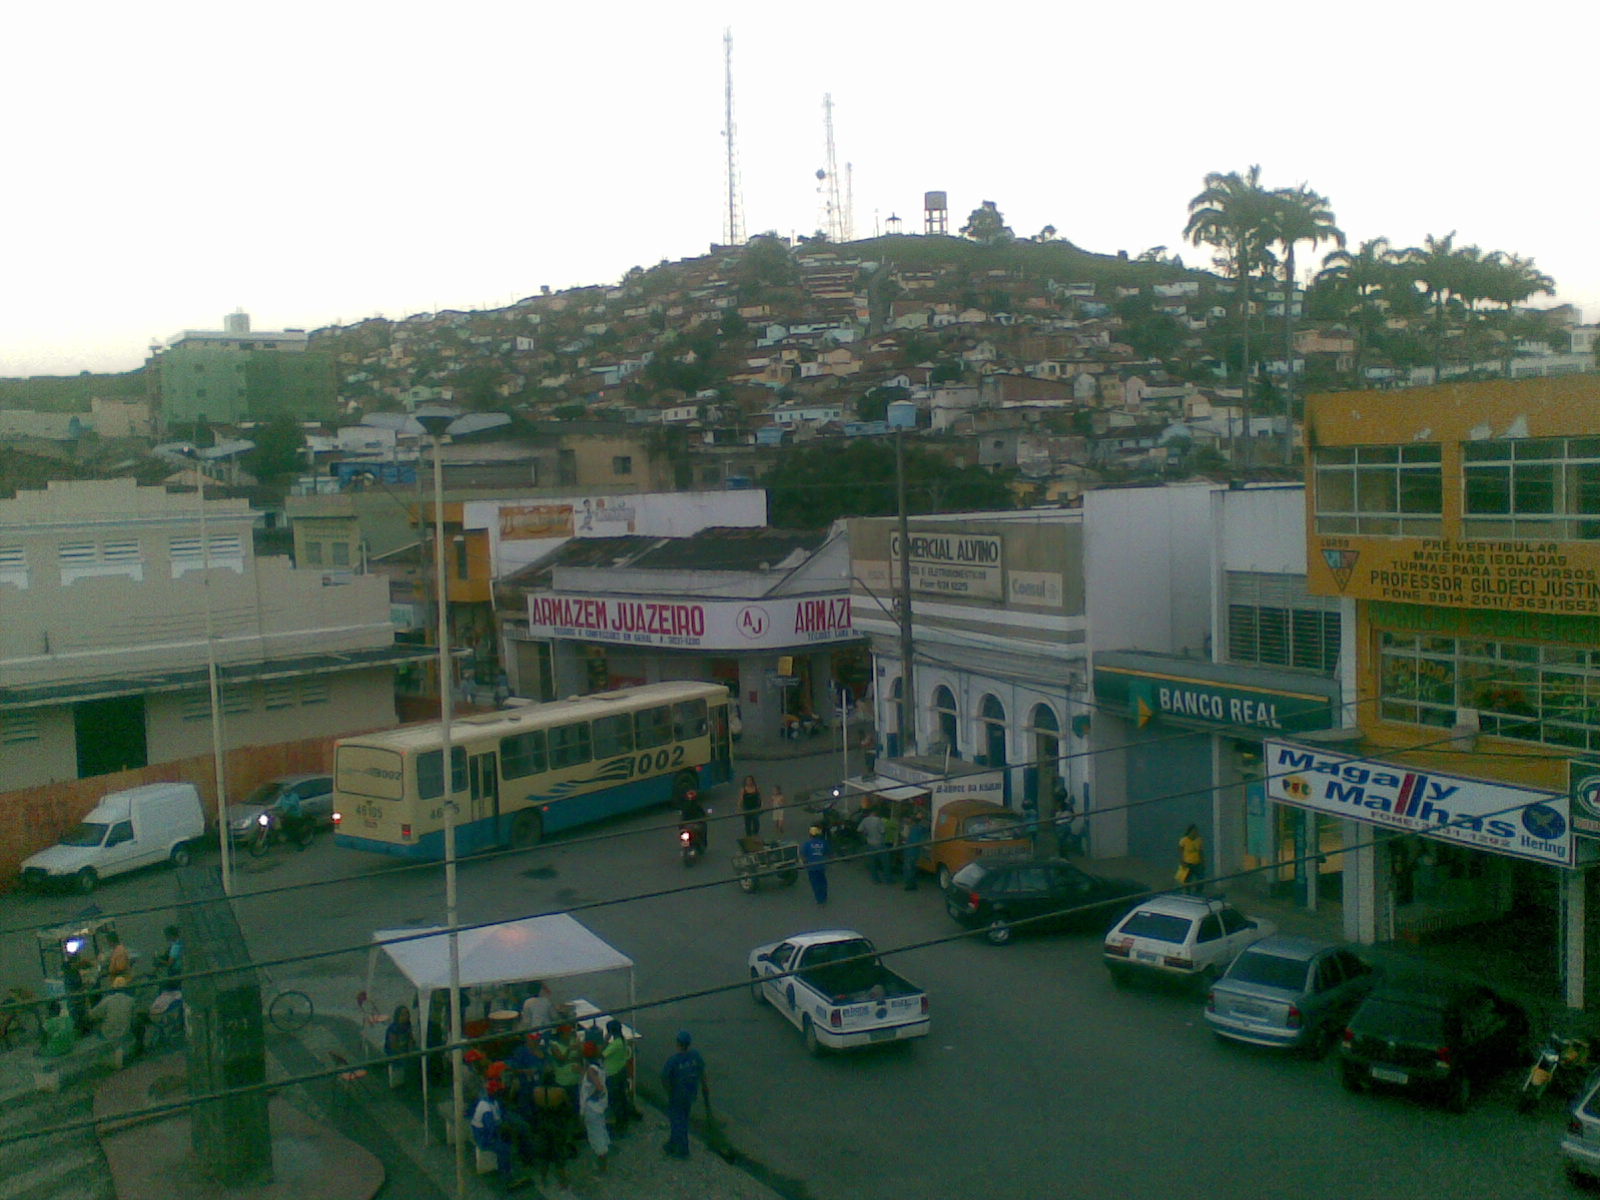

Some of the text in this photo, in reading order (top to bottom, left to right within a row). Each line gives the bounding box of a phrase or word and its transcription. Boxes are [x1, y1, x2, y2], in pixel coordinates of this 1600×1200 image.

[891, 536, 954, 562] CMERCIAL
[1456, 541, 1558, 553] VESTIBULAR
[1391, 559, 1595, 580] TURMAS PARA CONCURSOS
[1490, 553, 1567, 566] ISOLADAS
[1370, 570, 1463, 592] PROFESSOR
[1471, 577, 1536, 596] GILDECI
[1383, 588, 1421, 600] FONE
[532, 597, 706, 637] ARMAZEM JUAZEIRO
[1158, 687, 1283, 729] BANCO REAL
[627, 746, 686, 780] 1002
[430, 803, 461, 820] 465
[1520, 836, 1567, 858] Hering
